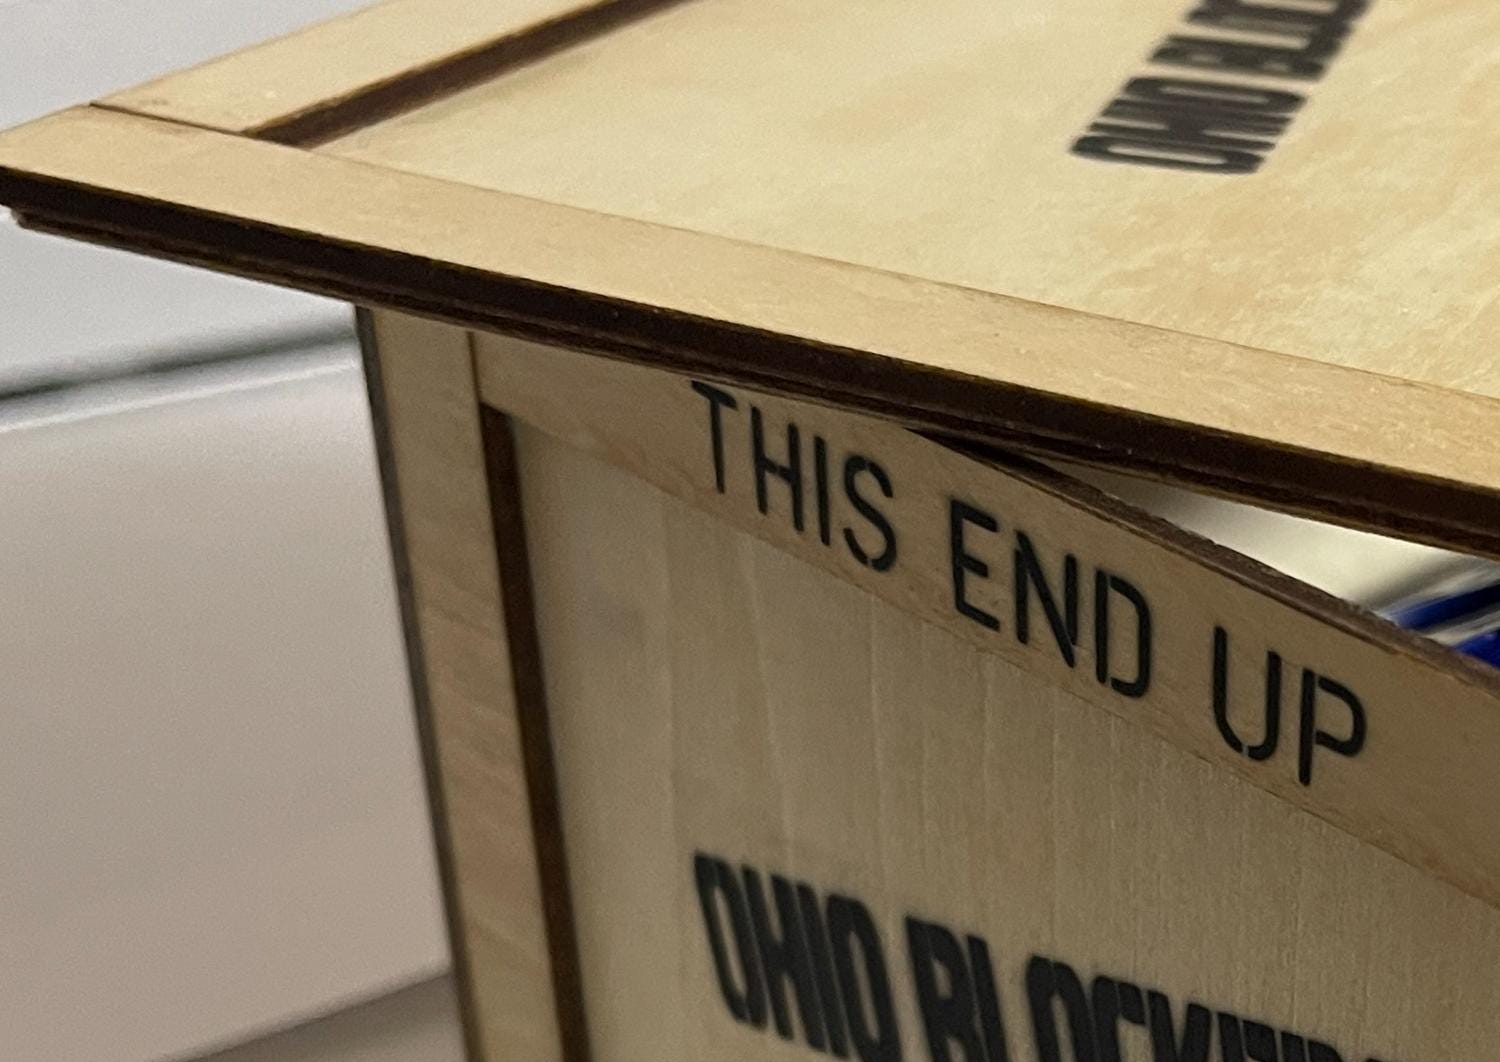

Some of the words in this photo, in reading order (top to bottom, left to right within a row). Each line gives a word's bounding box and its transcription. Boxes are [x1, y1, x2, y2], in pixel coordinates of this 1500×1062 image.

[1068, 76, 1309, 174] OHIO
[691, 379, 898, 573] THIS
[950, 496, 1152, 699] END
[1212, 626, 1367, 786] UP
